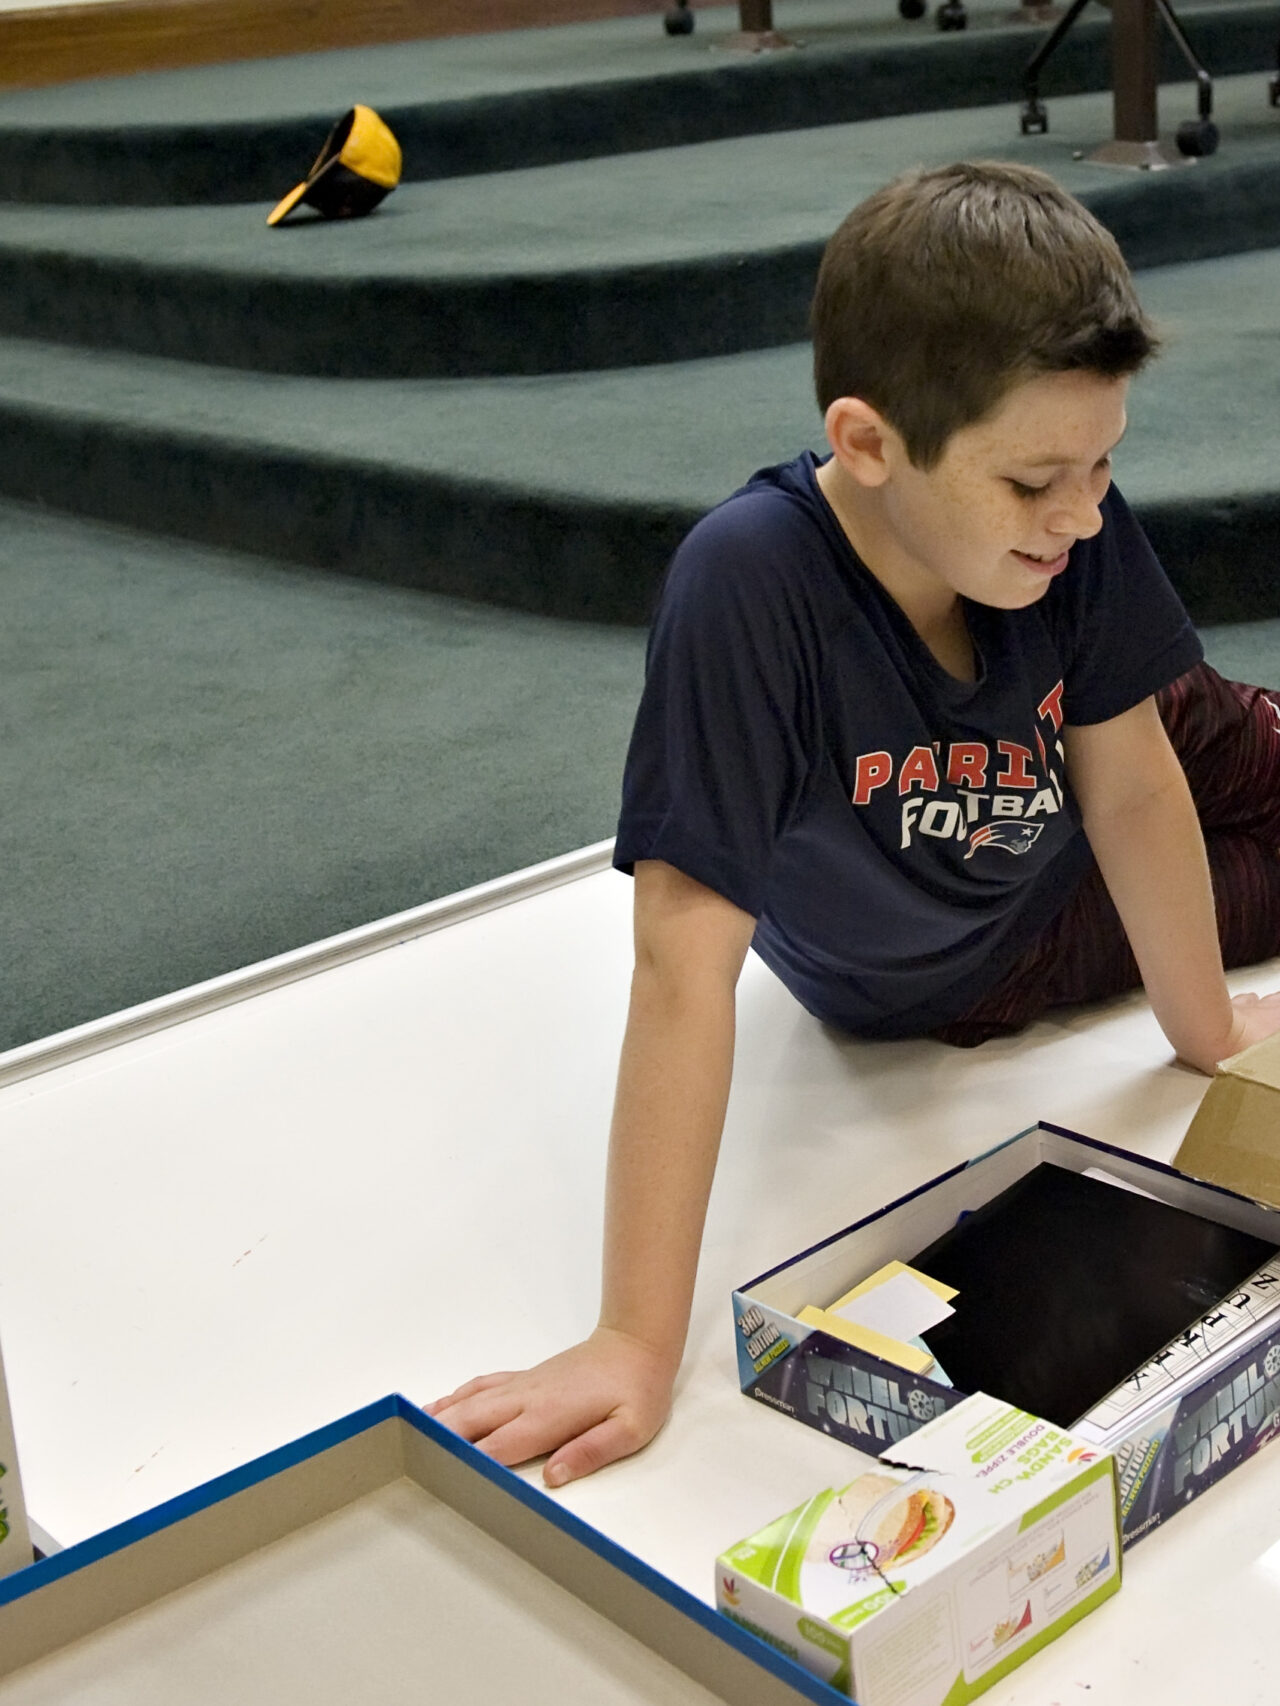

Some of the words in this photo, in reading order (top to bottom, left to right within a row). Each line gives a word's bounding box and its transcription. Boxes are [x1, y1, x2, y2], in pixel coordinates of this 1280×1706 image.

[737, 1305, 765, 1338] 3RD
[745, 1322, 782, 1361] EDITION
[1006, 1423, 1046, 1456] DOUBLE
[1016, 1430, 1060, 1464] BAGS
[975, 1455, 1008, 1478] ZIPPE
